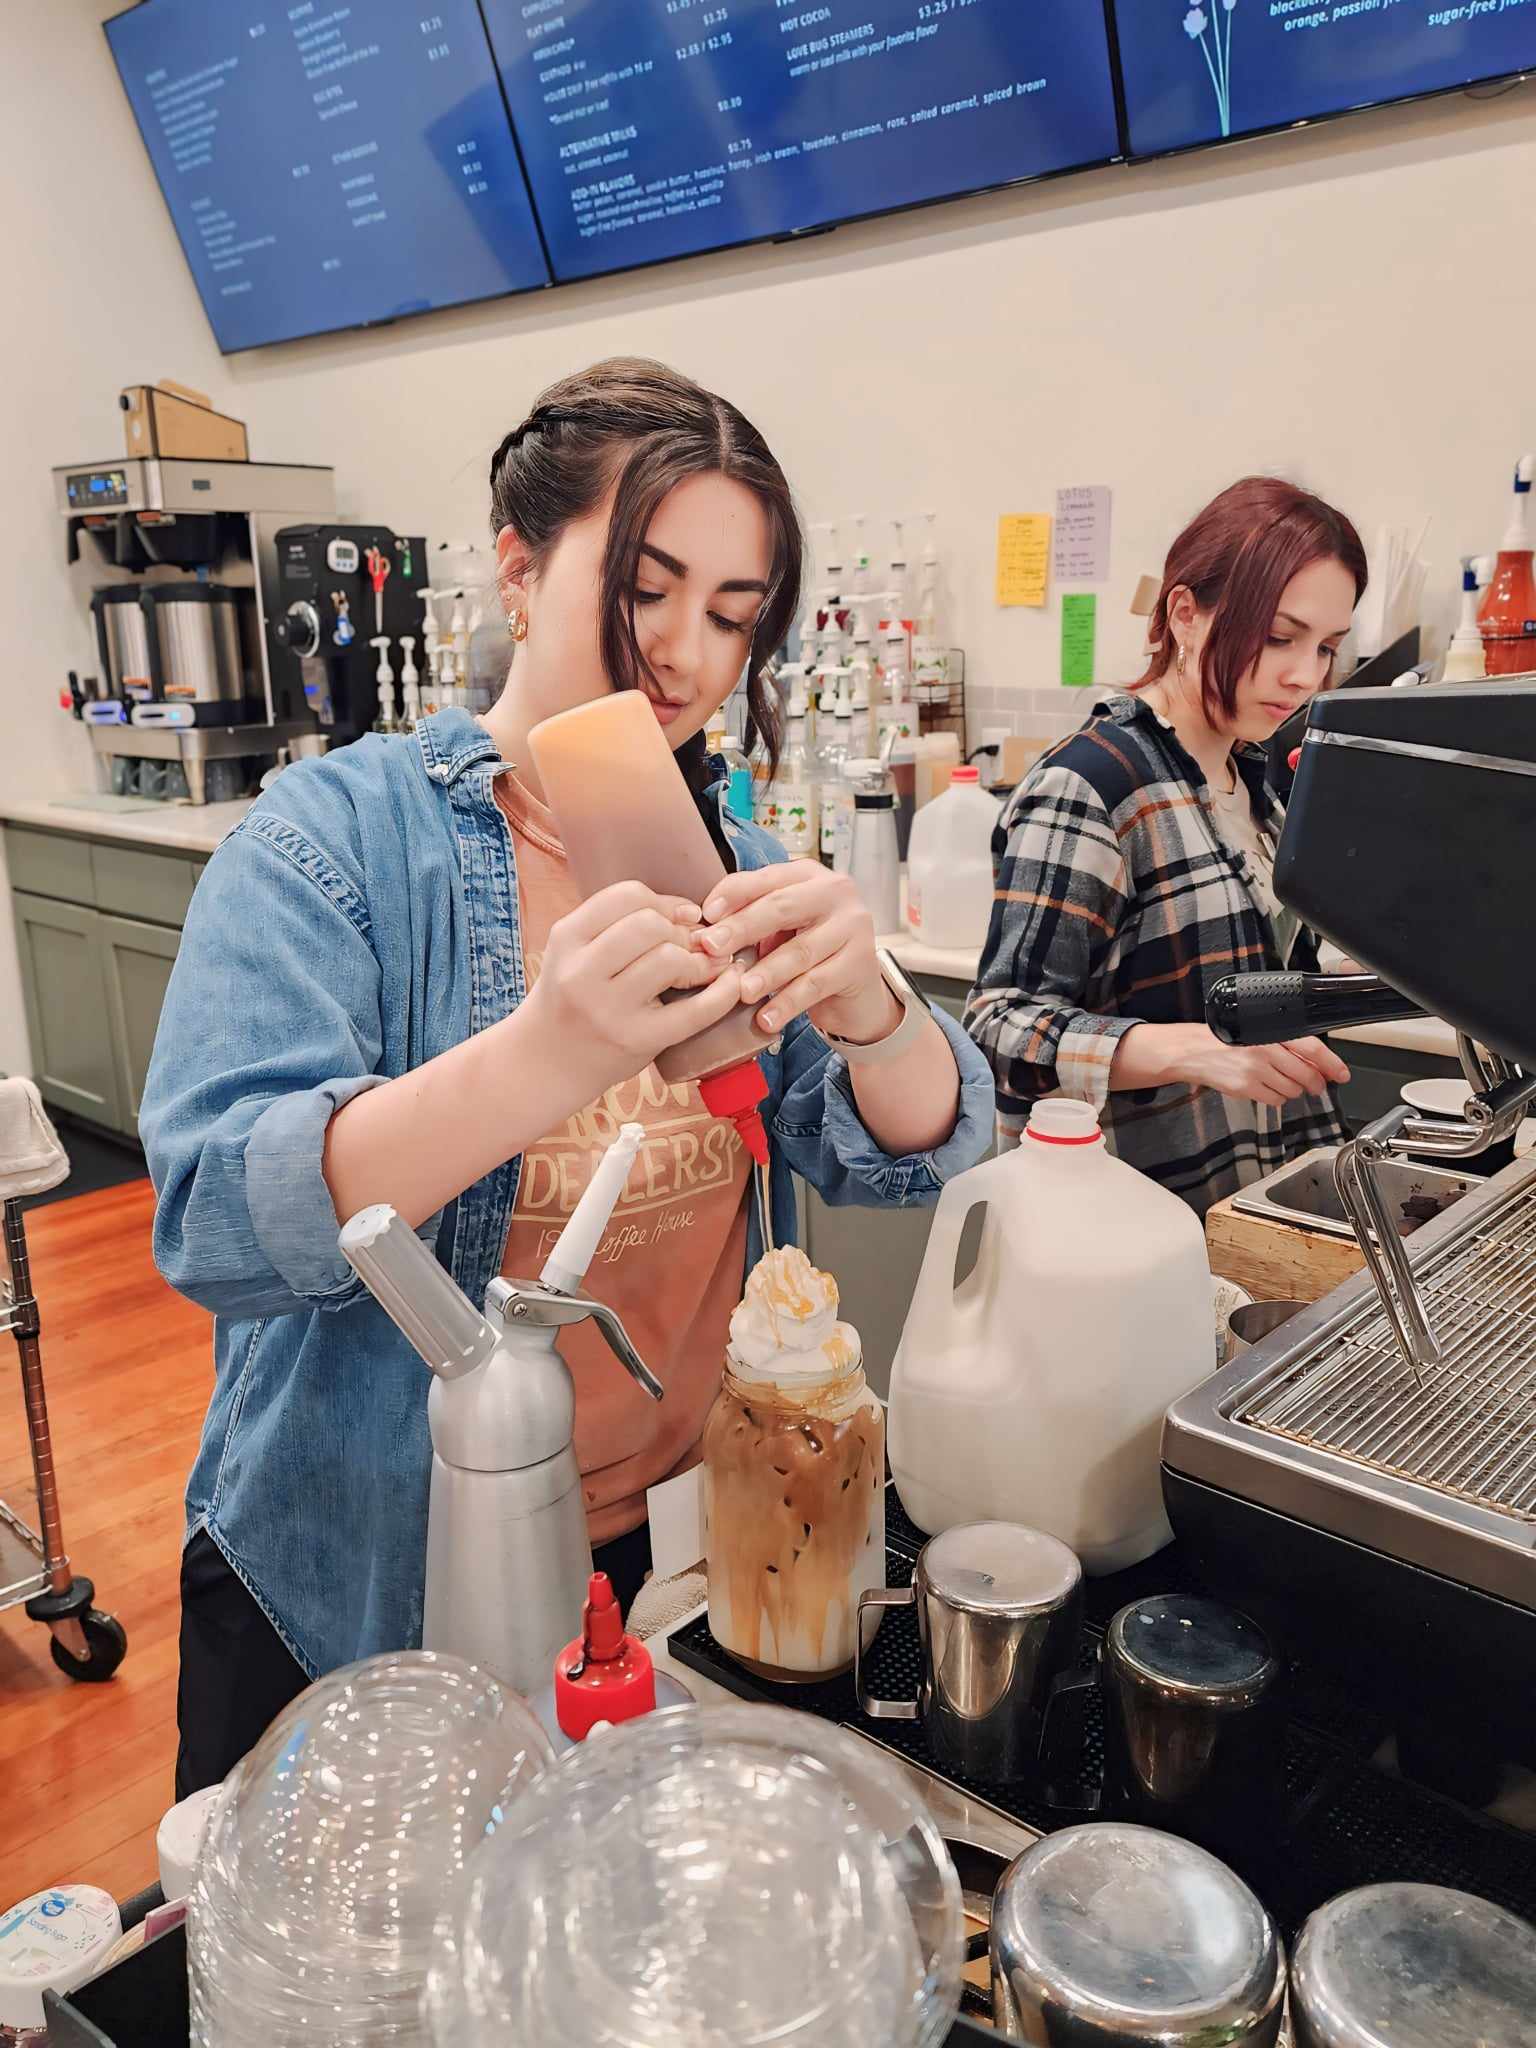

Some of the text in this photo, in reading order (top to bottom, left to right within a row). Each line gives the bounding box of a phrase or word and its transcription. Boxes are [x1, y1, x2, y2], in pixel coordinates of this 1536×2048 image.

[780, 7, 832, 33] HOT COCOA
[918, 0, 948, 19] $3.25
[1284, 11, 1329, 32] orange,
[1332, 0, 1380, 22] passion
[1428, 0, 1497, 26] sugar-free
[786, 24, 875, 61] LOVE BUG STEAMERS
[868, 40, 886, 56] your
[887, 117, 908, 129] rose,
[911, 106, 938, 124] salted
[941, 95, 980, 115] caramel,
[983, 84, 1013, 105] spiced
[1016, 78, 1047, 95] brown
[522, 1124, 726, 1212] DELERS
[650, 1210, 696, 1244] House
